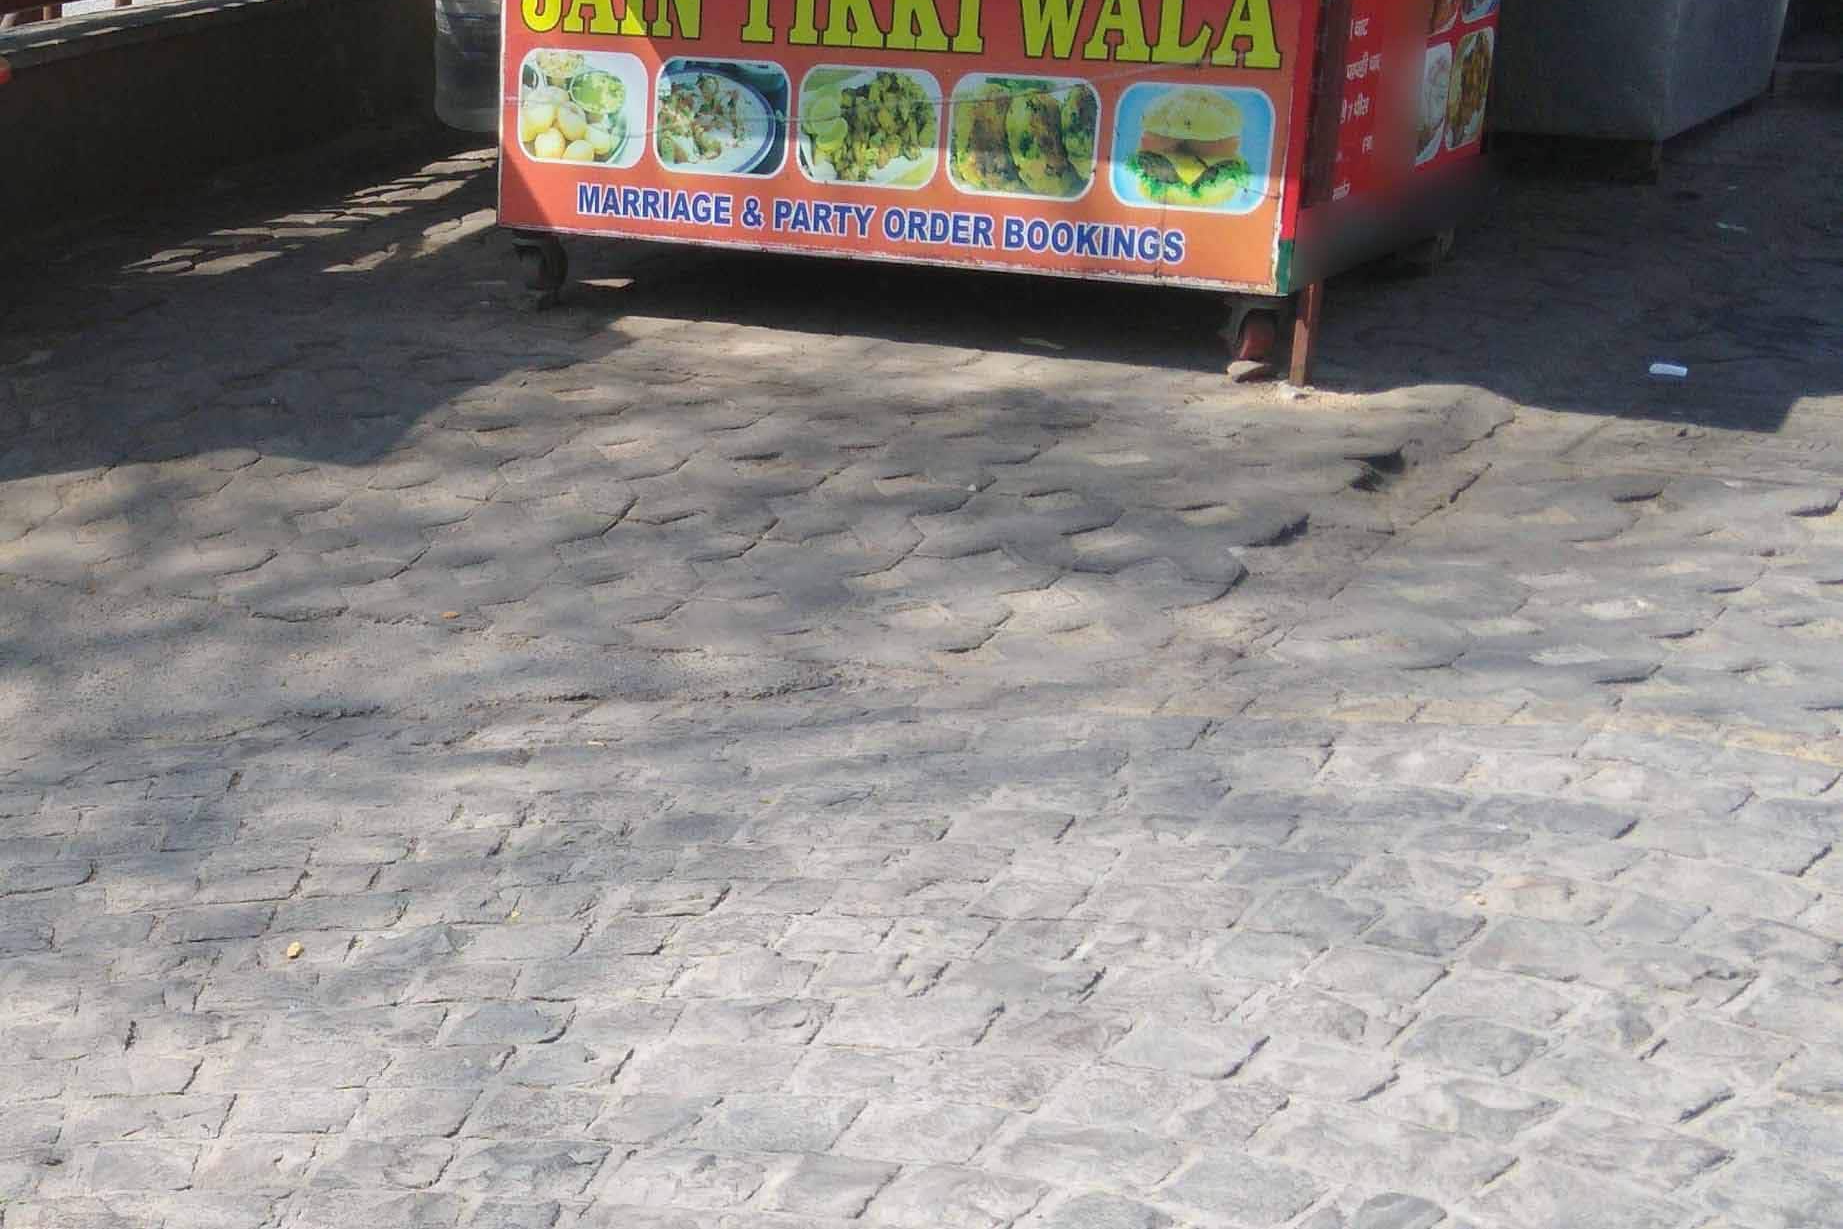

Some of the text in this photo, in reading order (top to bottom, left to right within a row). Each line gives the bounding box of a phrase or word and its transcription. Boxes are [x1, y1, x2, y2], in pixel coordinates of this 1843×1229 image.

[575, 181, 1187, 265] MARRIAGE & PARTY ORDER BOOKINGS
